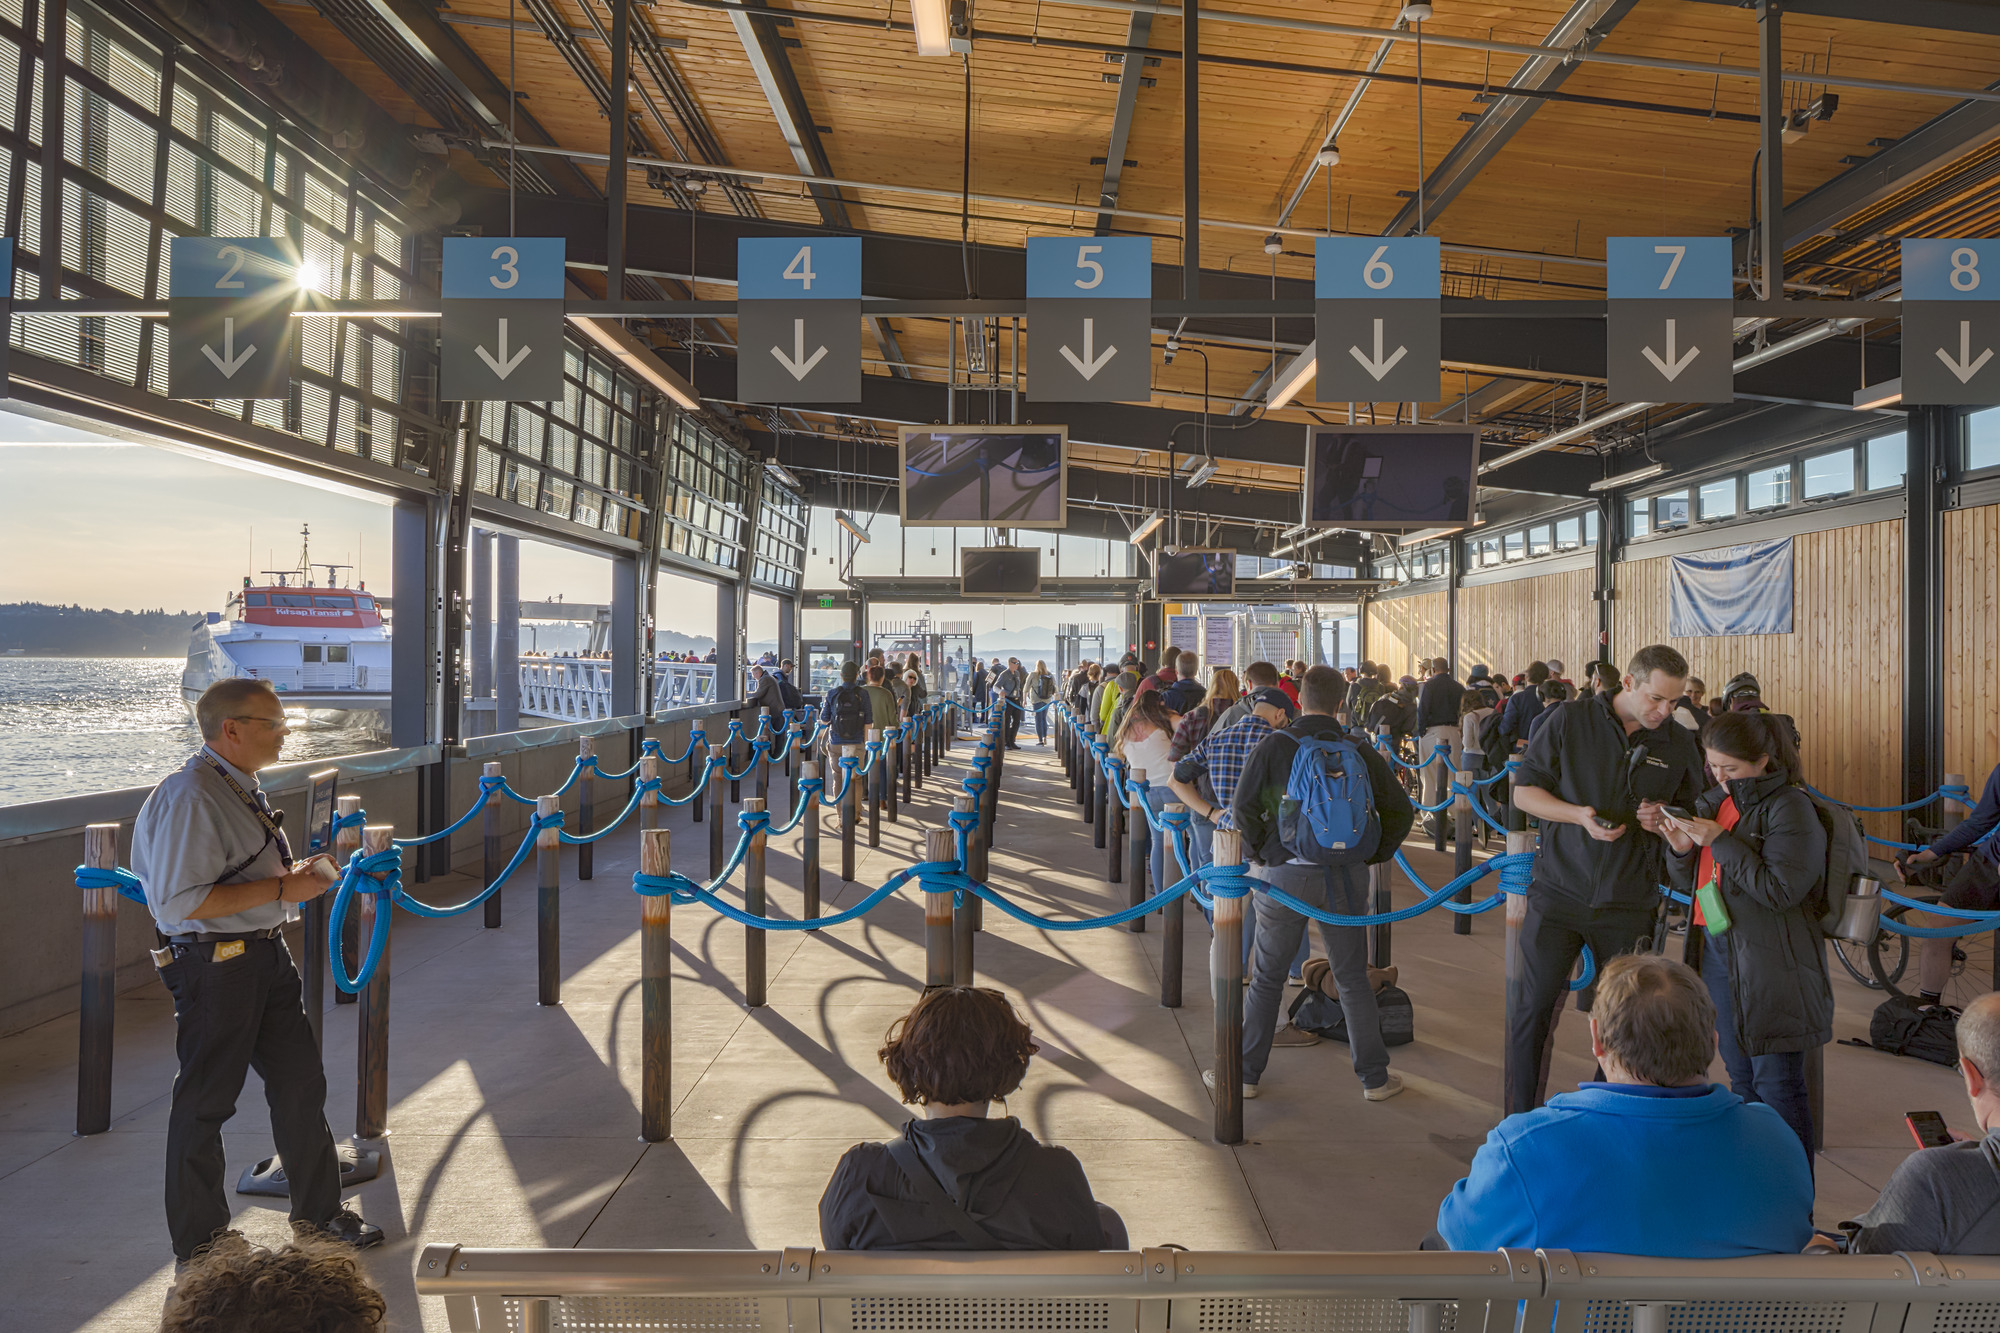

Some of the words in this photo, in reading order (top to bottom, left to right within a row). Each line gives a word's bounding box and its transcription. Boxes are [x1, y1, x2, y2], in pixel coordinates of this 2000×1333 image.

[215, 245, 245, 288] 2
[489, 246, 519, 289] 3
[782, 246, 816, 290] 4
[1074, 245, 1104, 290] 5
[1363, 245, 1394, 290] 6
[1654, 246, 1686, 290] 7
[1950, 247, 1980, 291] 8
[275, 608, 308, 616] Kitsap
[309, 608, 341, 616] Transit
[820, 599, 832, 608] EXIT
[223, 773, 252, 805] HUSKIES
